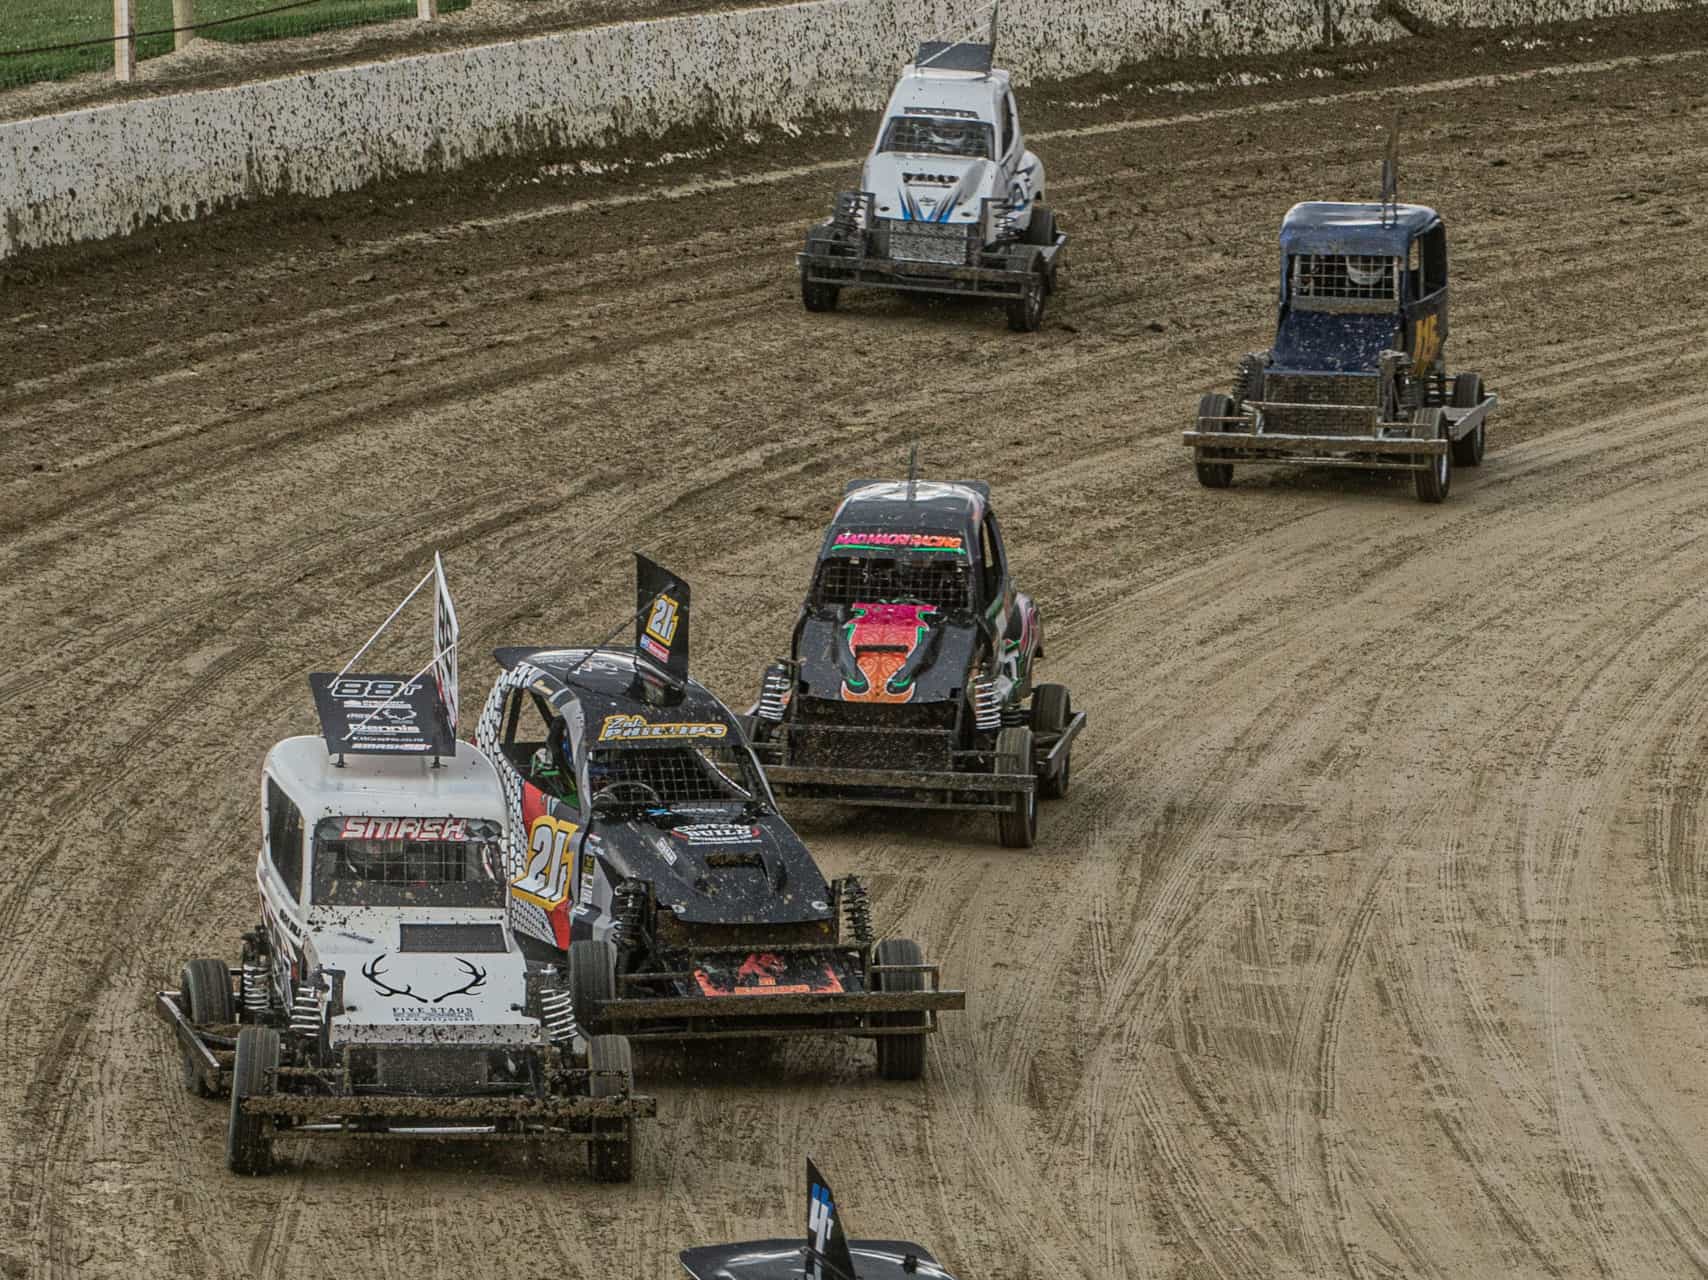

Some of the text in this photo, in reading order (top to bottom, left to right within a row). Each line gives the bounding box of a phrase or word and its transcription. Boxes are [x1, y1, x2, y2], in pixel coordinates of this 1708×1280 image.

[911, 533, 962, 548] RACING
[604, 726, 724, 738] PHILLIPS
[342, 817, 467, 841] SMASH
